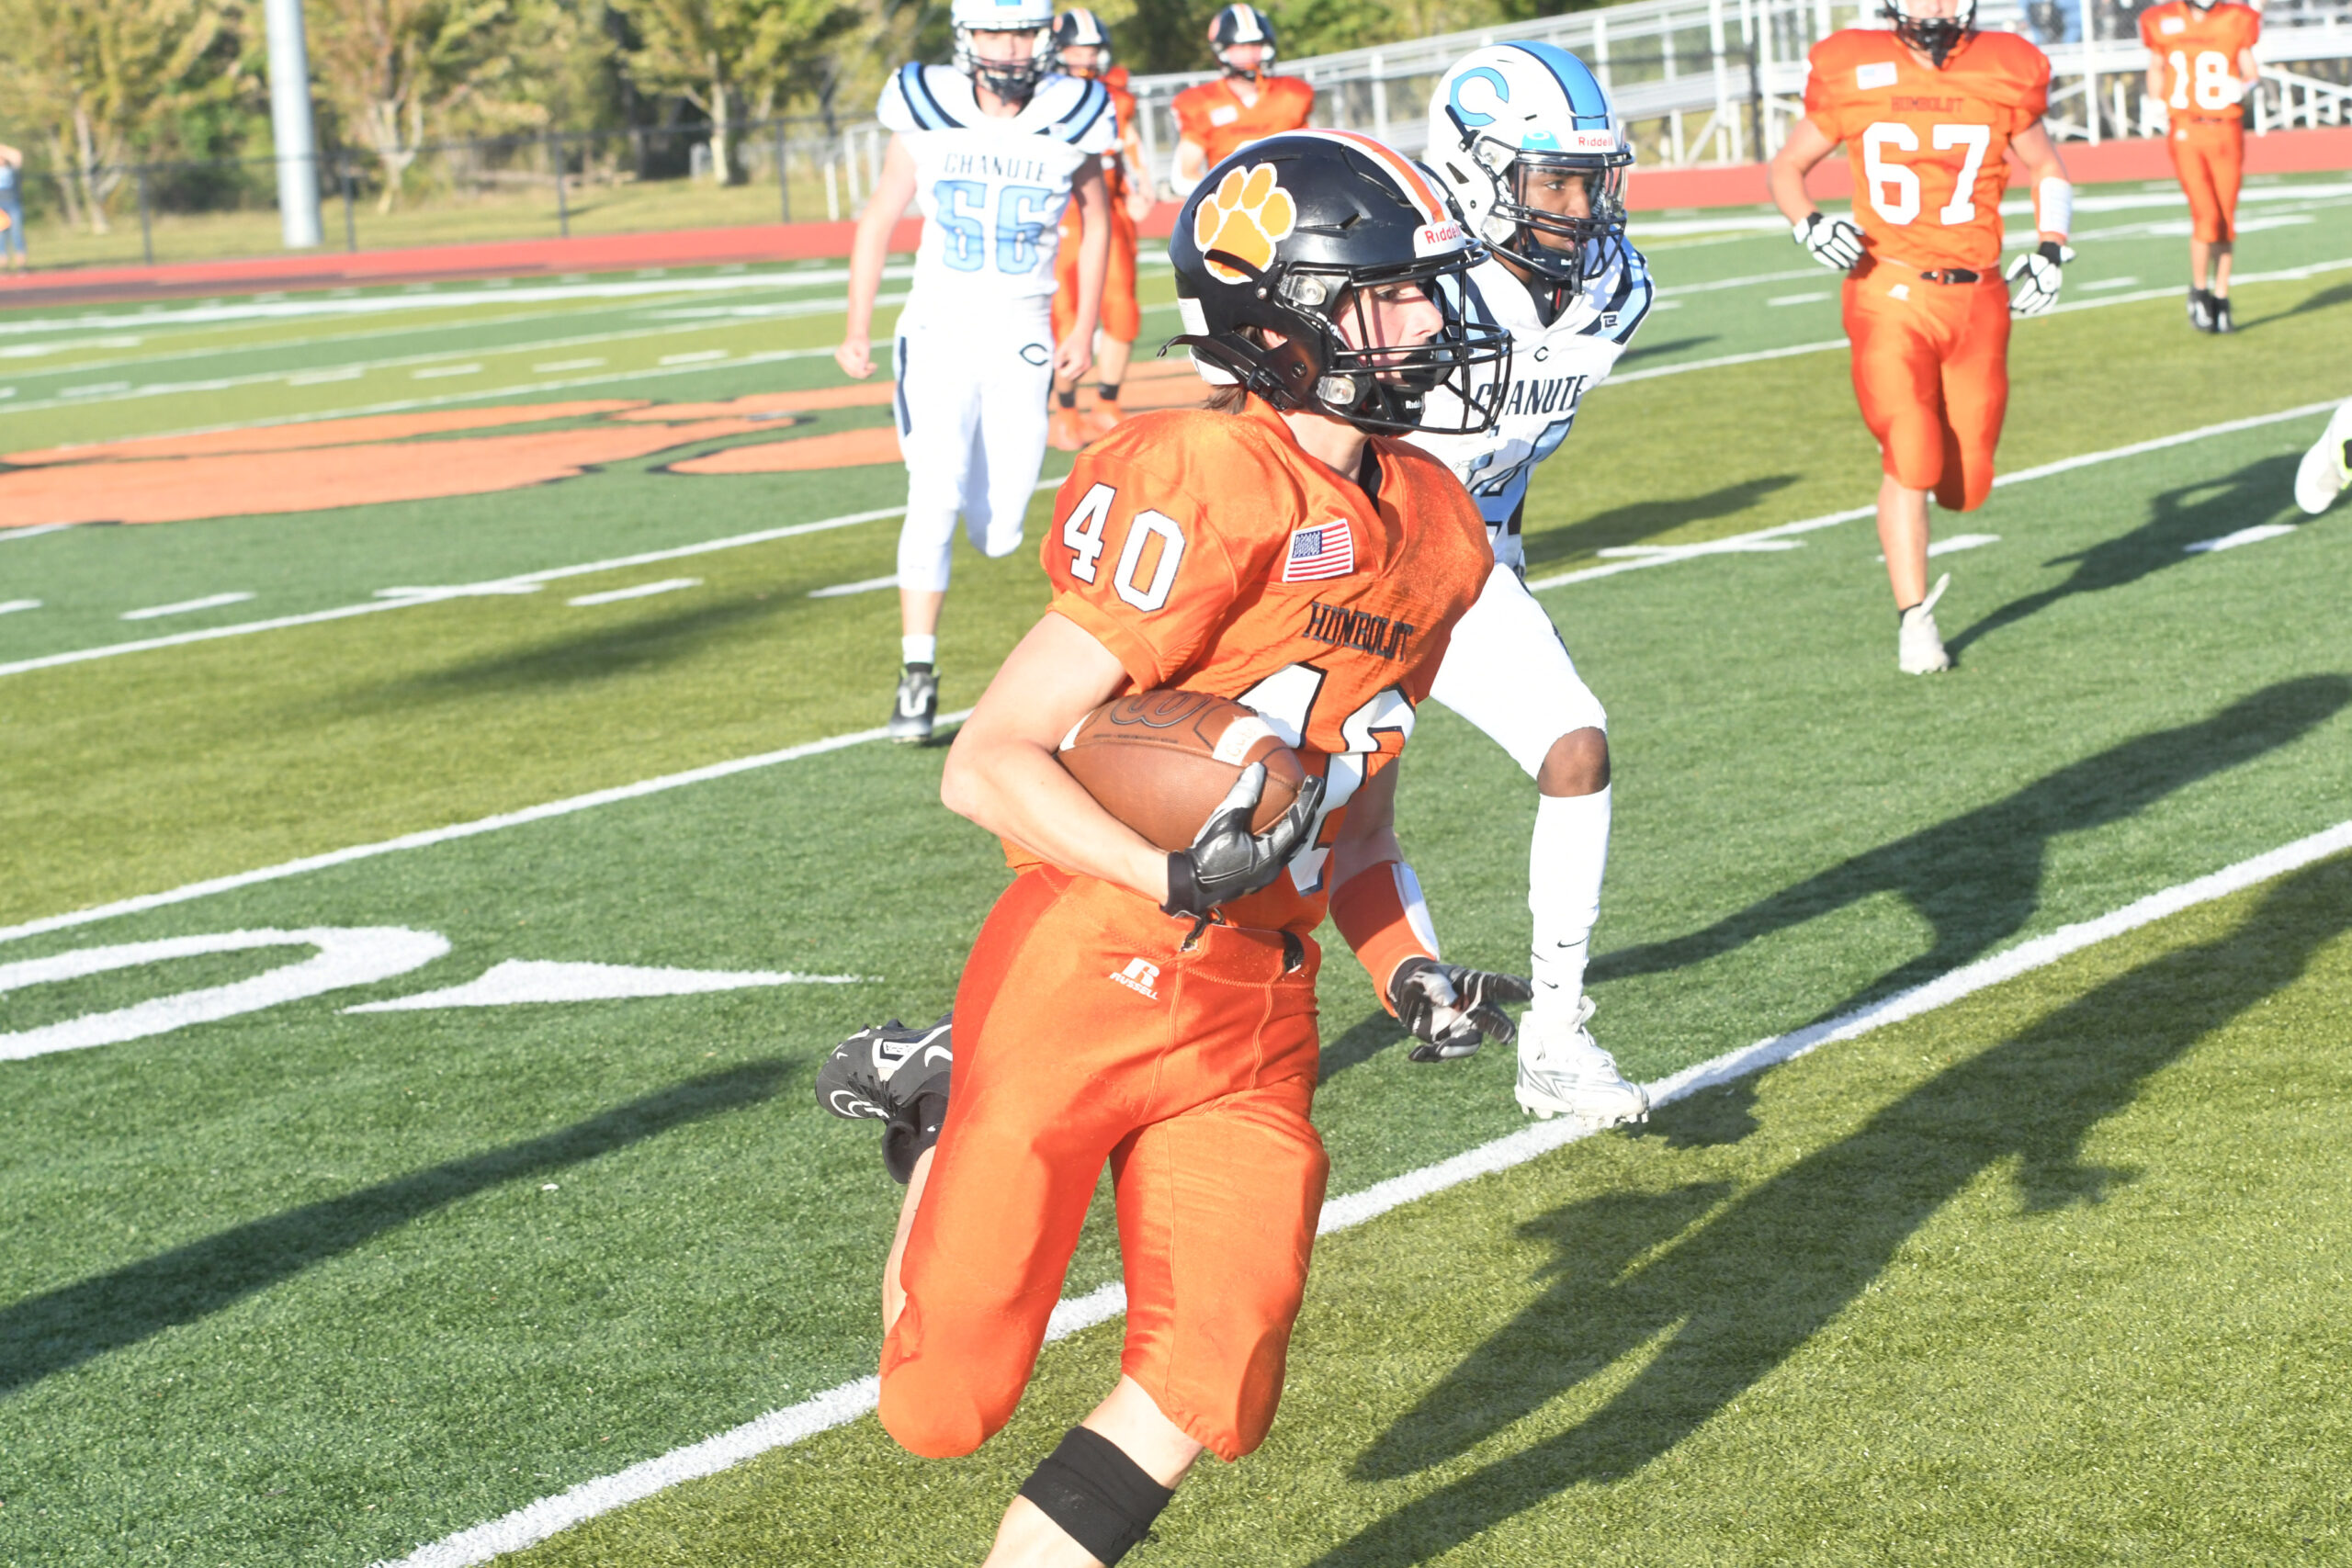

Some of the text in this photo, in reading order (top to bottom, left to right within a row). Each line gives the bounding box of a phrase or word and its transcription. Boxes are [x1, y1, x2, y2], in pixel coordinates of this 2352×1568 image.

[2168, 50, 2231, 110] 18
[1577, 136, 1613, 147] Riddell
[944, 152, 1045, 182] CHANUTE
[1862, 121, 1990, 225] 67
[1424, 223, 1461, 244] Riddell
[1062, 481, 1187, 613] 40
[1109, 971, 1158, 1000] RUSSELL
